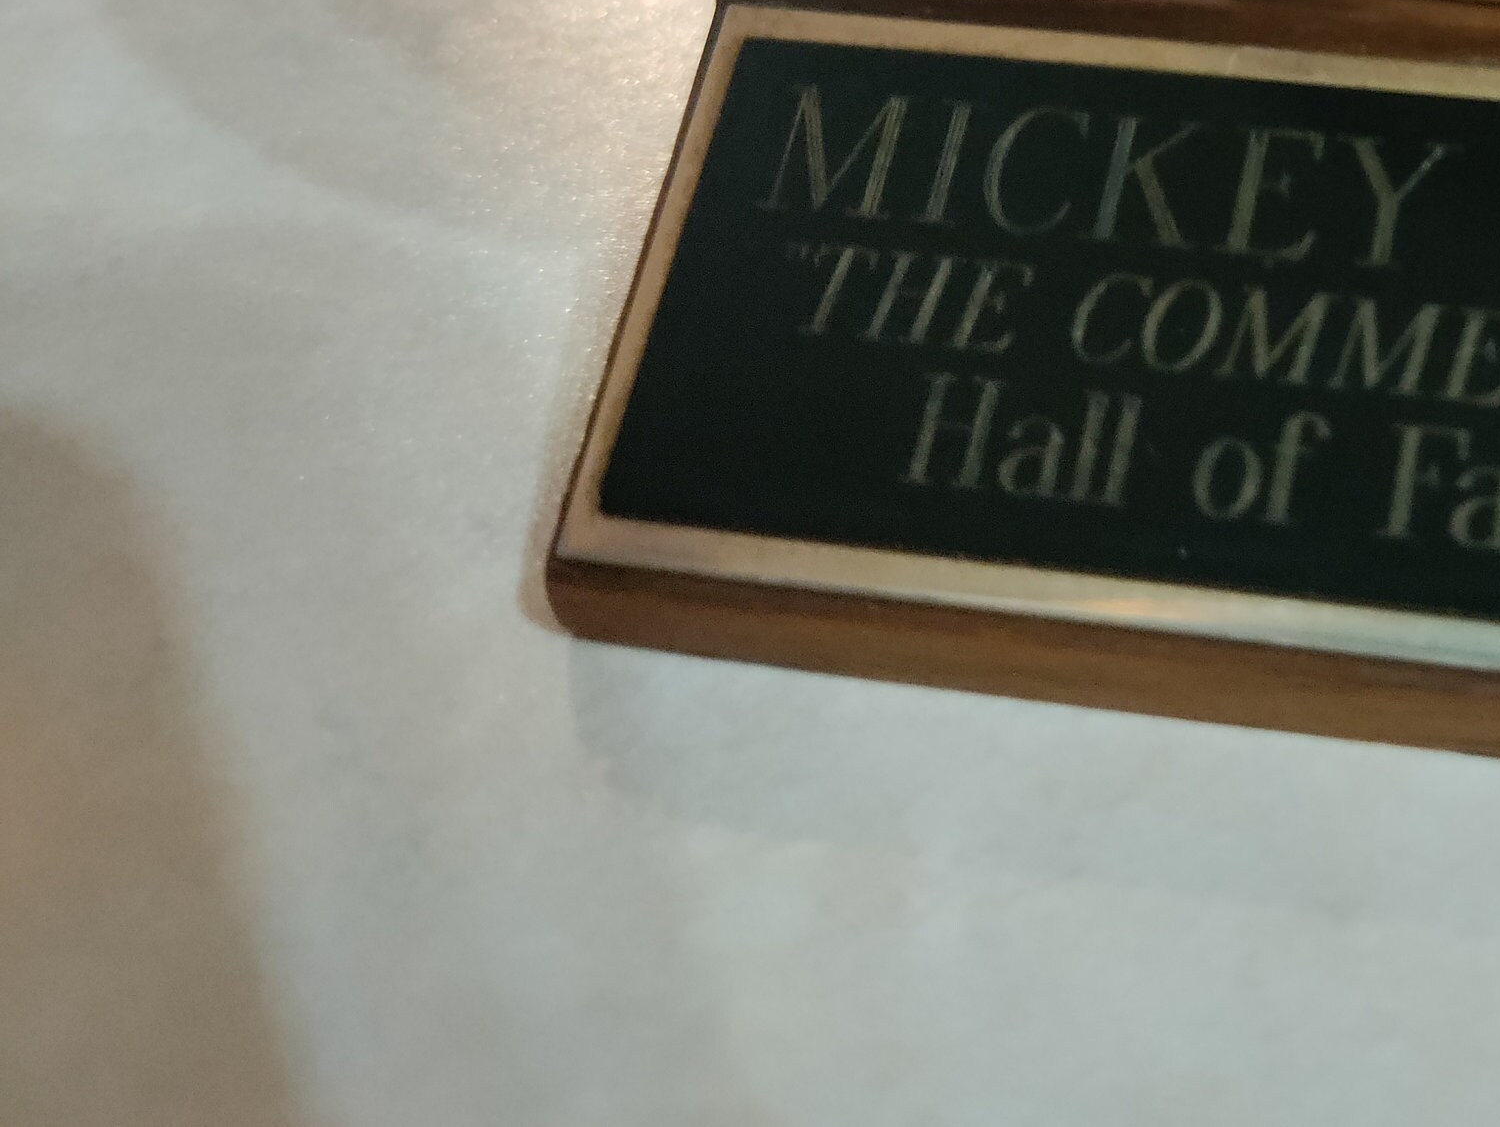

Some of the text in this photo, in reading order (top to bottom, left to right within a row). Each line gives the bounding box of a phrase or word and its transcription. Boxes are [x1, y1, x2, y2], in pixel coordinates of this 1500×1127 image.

[759, 83, 1463, 269] MICKEY
[903, 371, 1145, 508] Hall
[1196, 410, 1332, 526] of
